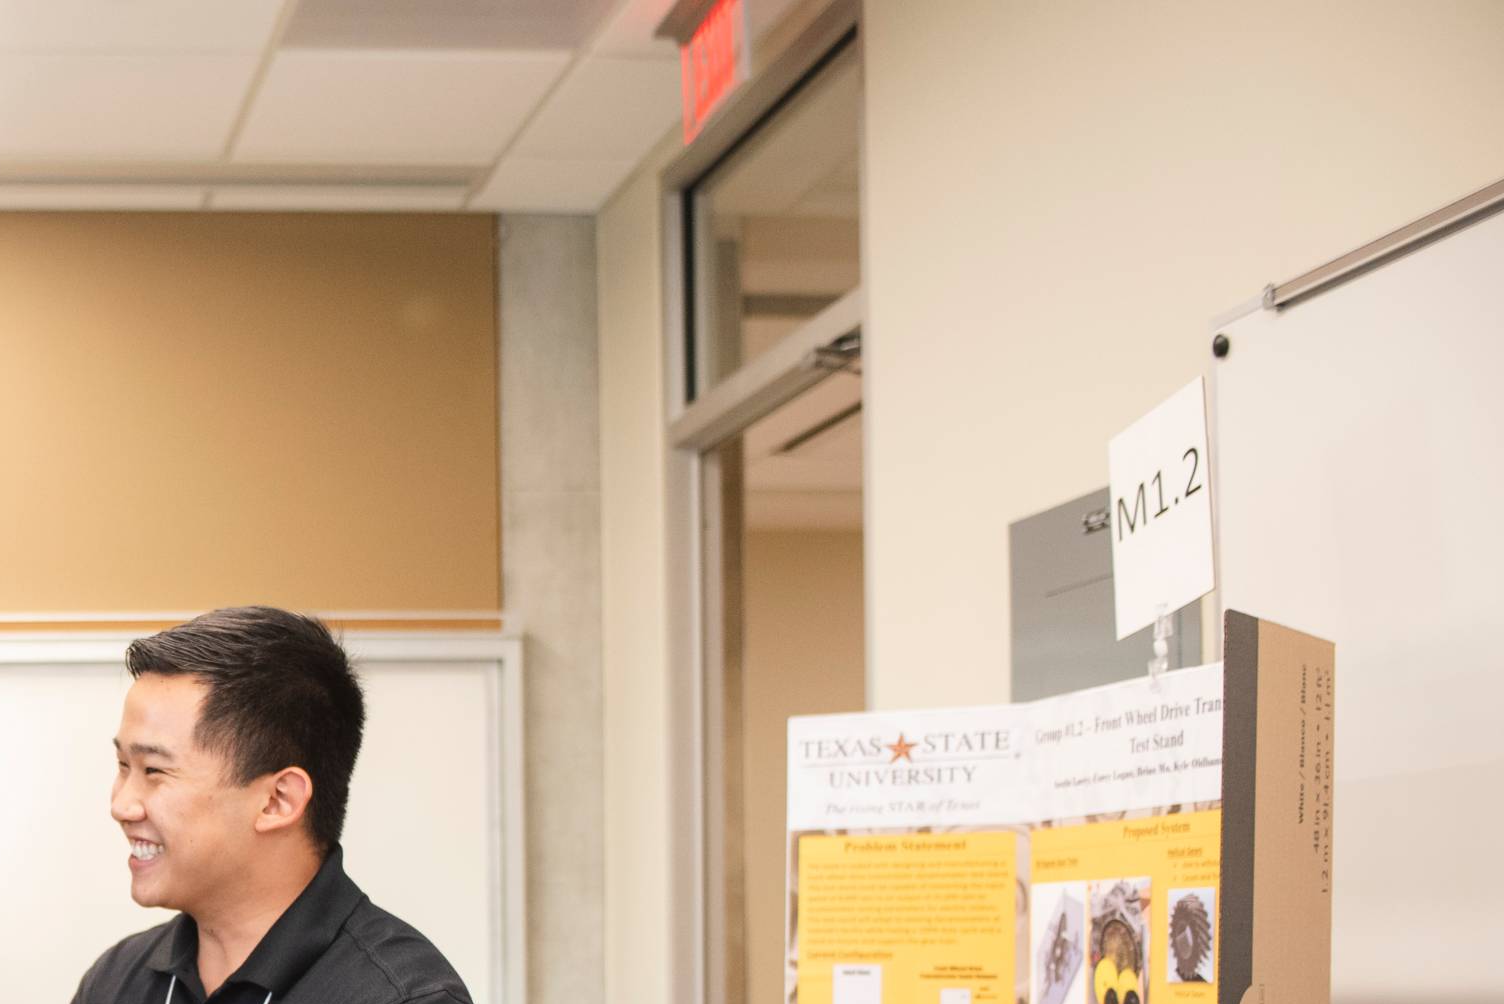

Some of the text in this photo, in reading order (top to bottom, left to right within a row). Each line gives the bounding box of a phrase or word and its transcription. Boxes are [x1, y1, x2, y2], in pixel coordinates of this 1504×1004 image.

[1117, 447, 1202, 541] M1.2
[1094, 715, 1122, 733] Front
[1125, 706, 1157, 725] Wheel
[1160, 703, 1191, 721] Drive
[800, 731, 1010, 760] TEXAS STATE
[1130, 730, 1184, 755] Test Stand
[829, 766, 977, 789] UNIVERSITY
[1297, 784, 1305, 824] White
